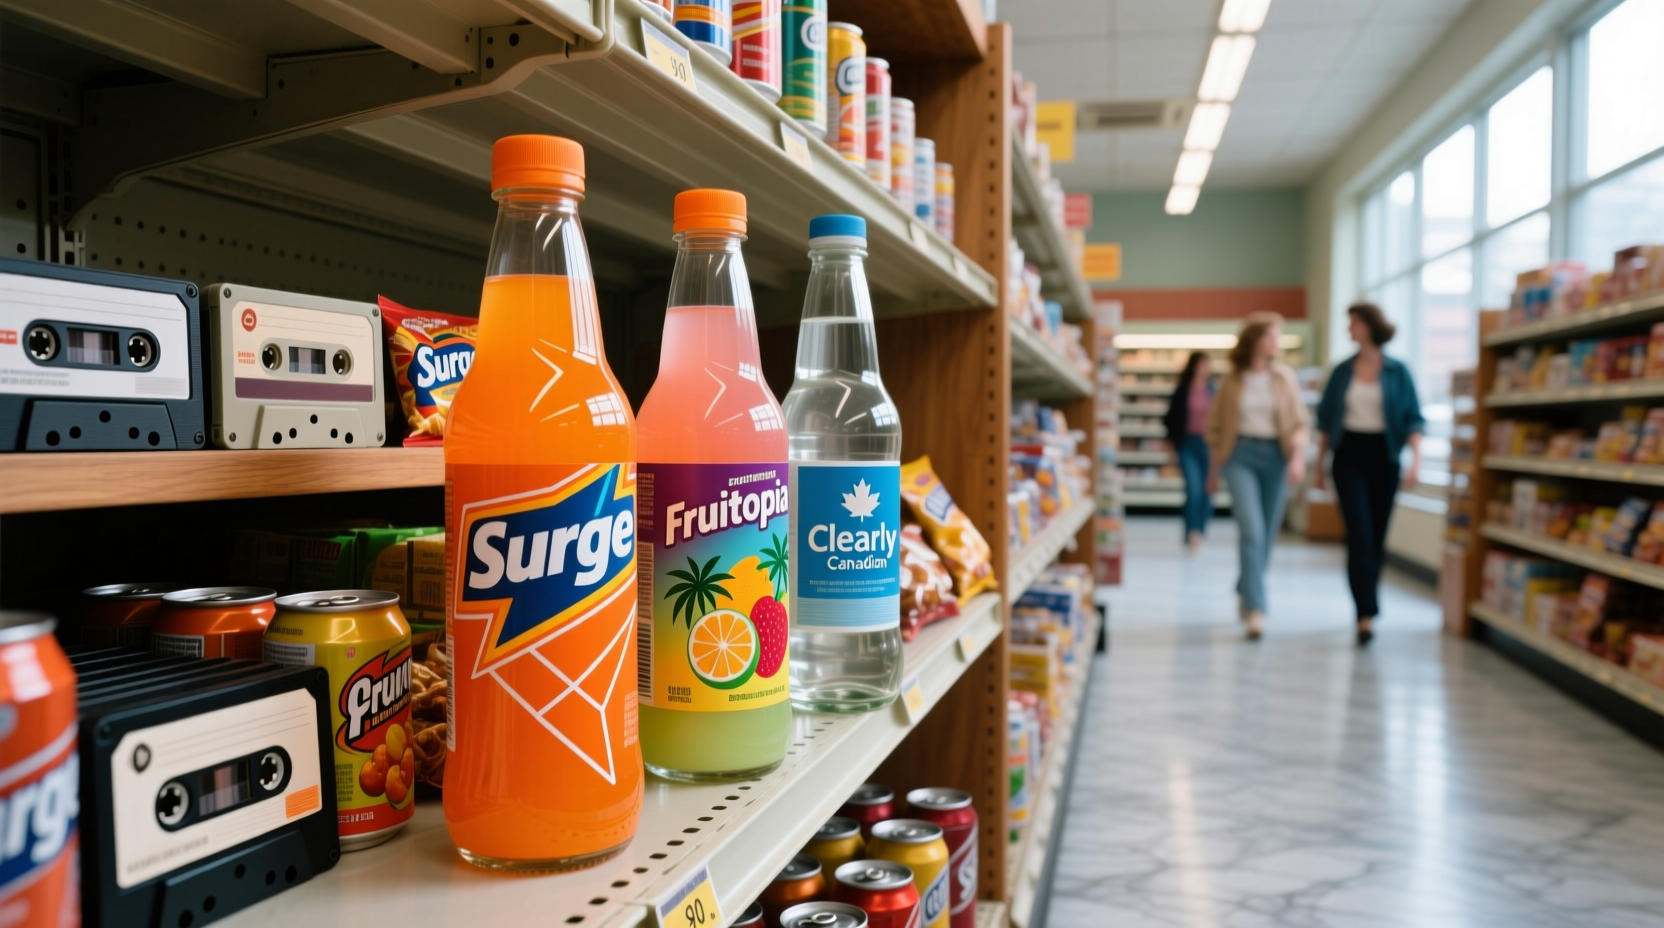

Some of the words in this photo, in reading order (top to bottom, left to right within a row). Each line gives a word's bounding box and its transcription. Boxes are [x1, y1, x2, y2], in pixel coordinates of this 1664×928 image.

[664, 479, 789, 546] Fruitopia
[808, 522, 897, 558] Clearly
[468, 509, 634, 589] Surge
